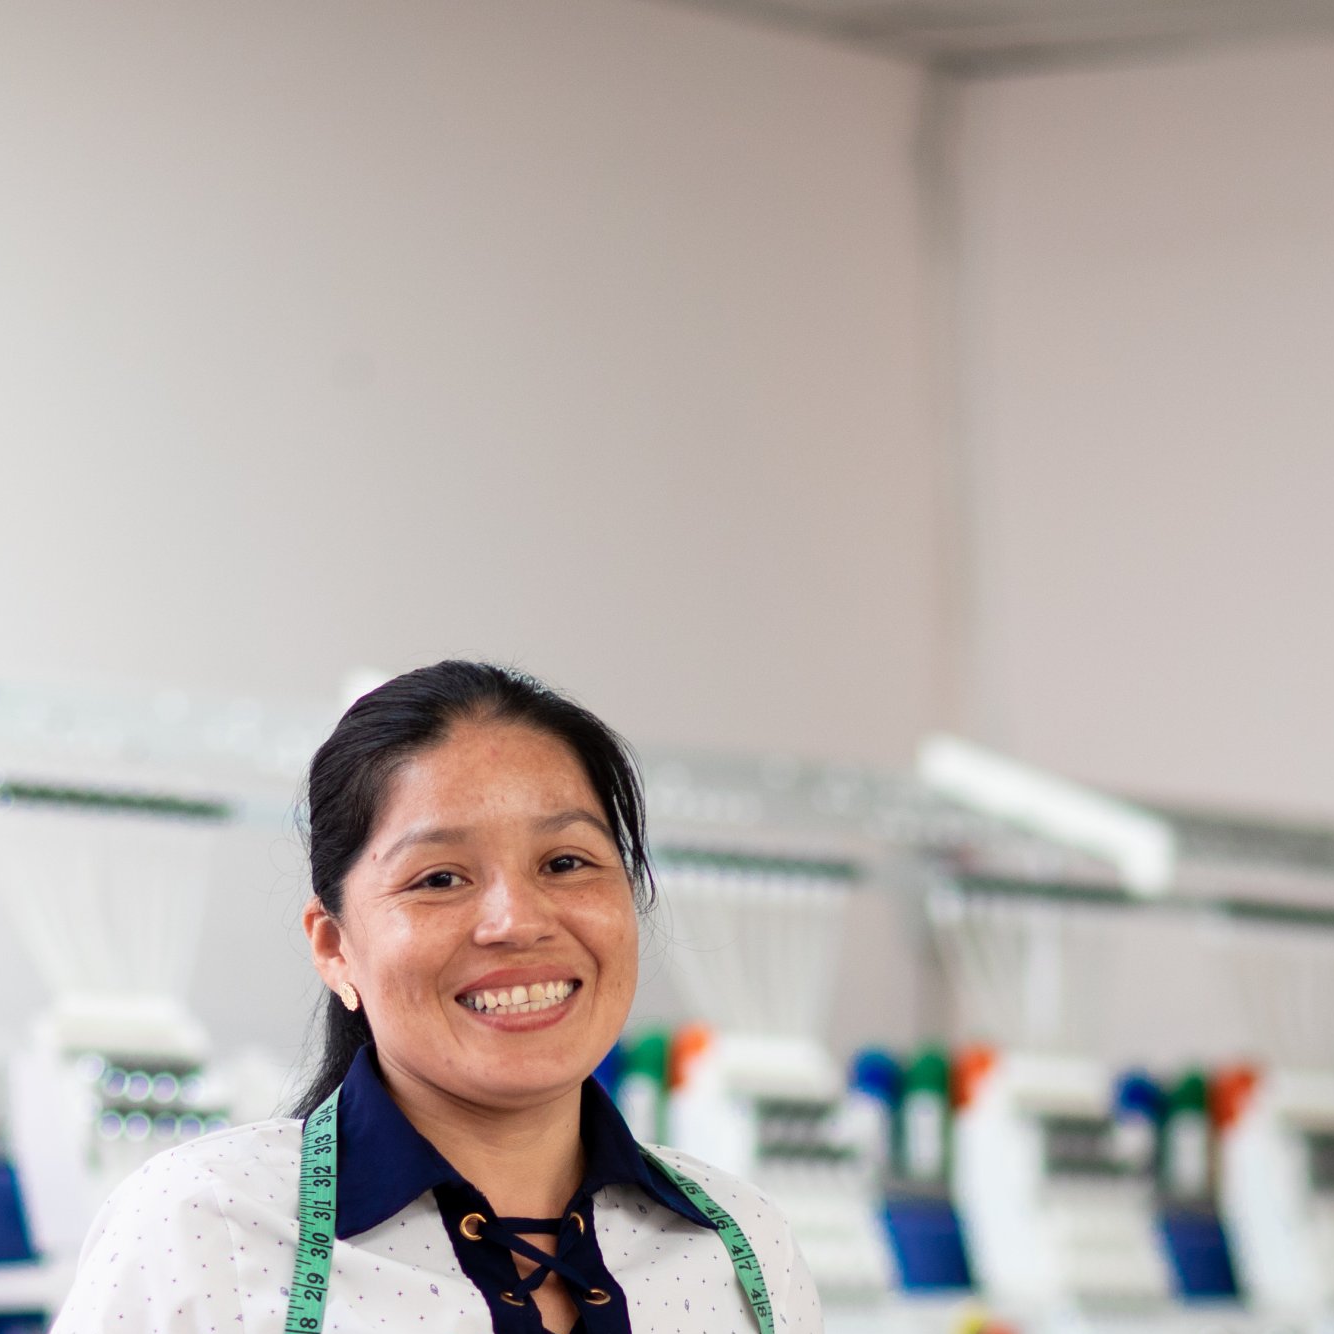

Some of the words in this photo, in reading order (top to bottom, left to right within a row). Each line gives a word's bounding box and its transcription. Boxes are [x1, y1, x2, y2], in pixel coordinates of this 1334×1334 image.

[316, 1104, 333, 1126] 34
[314, 1133, 333, 1155] 33
[313, 1165, 332, 1187] 32
[313, 1199, 331, 1221] 31
[310, 1232, 330, 1260] 30
[705, 1206, 730, 1230] 46
[730, 1244, 753, 1271] 47
[750, 1289, 767, 1318] 48
[303, 1271, 325, 1302] 29
